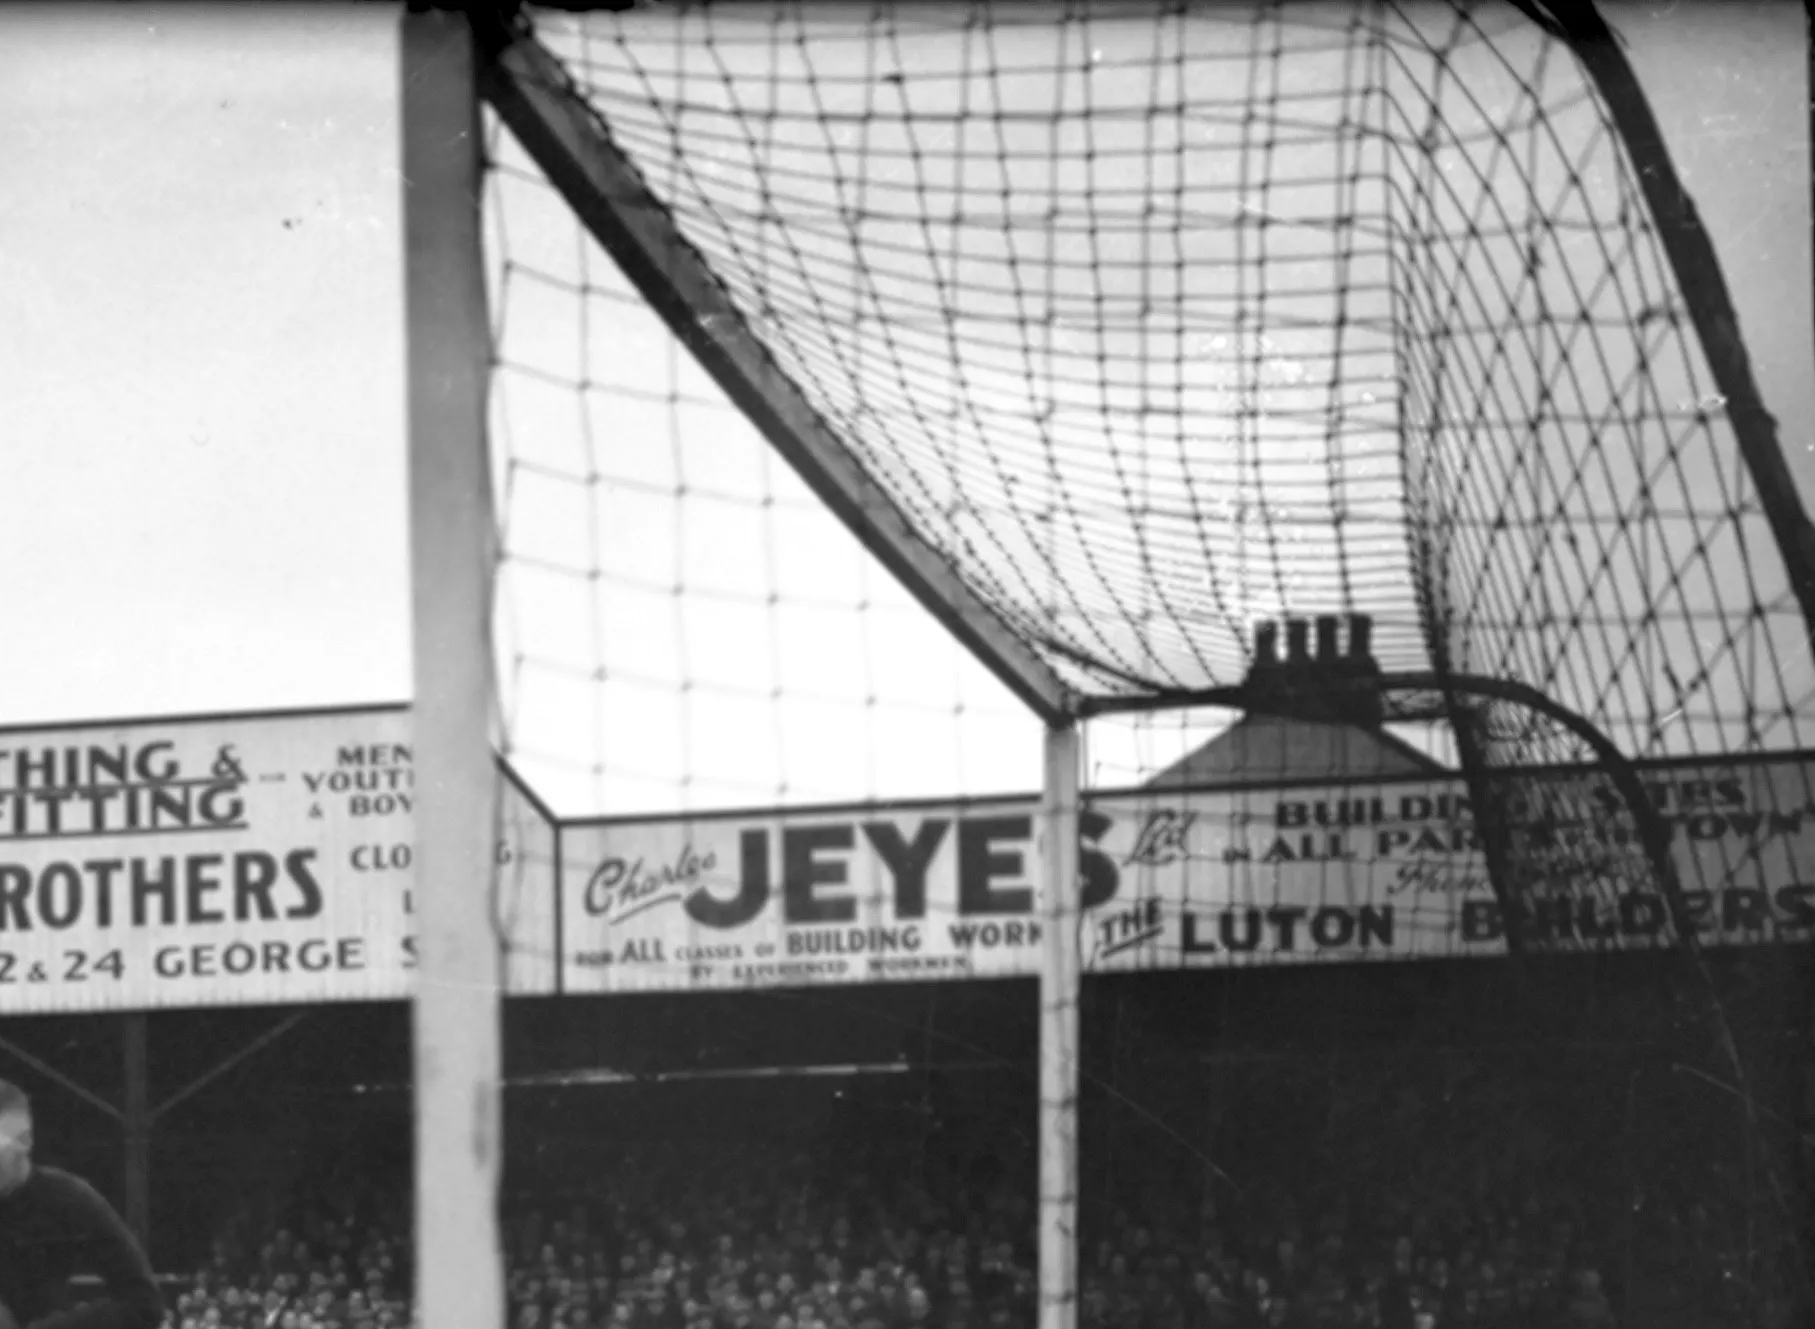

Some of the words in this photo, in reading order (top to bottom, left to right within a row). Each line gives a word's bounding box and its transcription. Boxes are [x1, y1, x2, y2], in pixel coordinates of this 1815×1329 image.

[211, 743, 248, 784] &
[338, 745, 415, 767] MEN
[302, 768, 415, 797] YOUT
[1275, 793, 1474, 828] BUILDIN
[1262, 832, 1357, 863] ALL
[584, 843, 718, 917] Charles
[620, 937, 665, 964] ALL
[675, 944, 744, 962] CLASSES
[786, 925, 922, 956] BUILDING
[1099, 897, 1163, 946] THE
[1181, 903, 1395, 953] LUTON
[26, 961, 48, 982] &
[63, 949, 125, 982] 24
[153, 937, 366, 979] GEORGE
